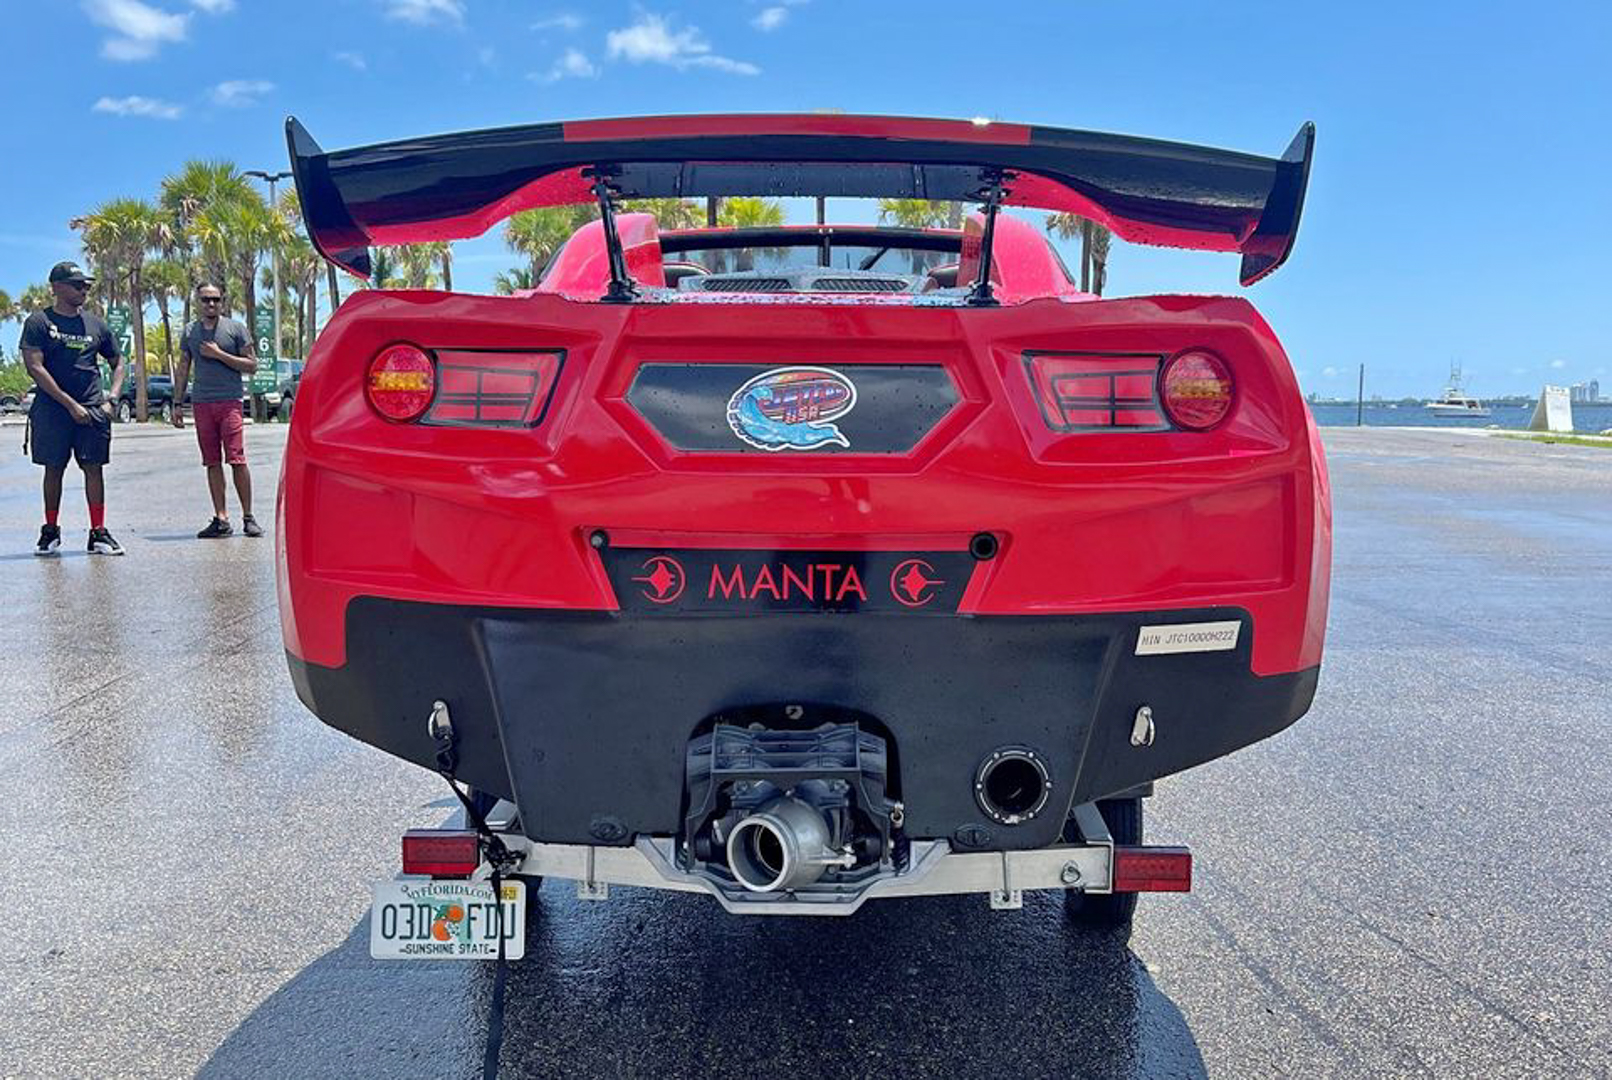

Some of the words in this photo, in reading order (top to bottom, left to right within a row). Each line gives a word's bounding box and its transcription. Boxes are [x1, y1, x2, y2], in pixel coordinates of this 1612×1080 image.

[119, 337, 129, 352] 7
[259, 336, 269, 352] 6
[707, 563, 867, 601] MANTA
[1142, 636, 1160, 645] HIN
[405, 943, 455, 955] SUNSHINE
[458, 943, 490, 955] STATE
